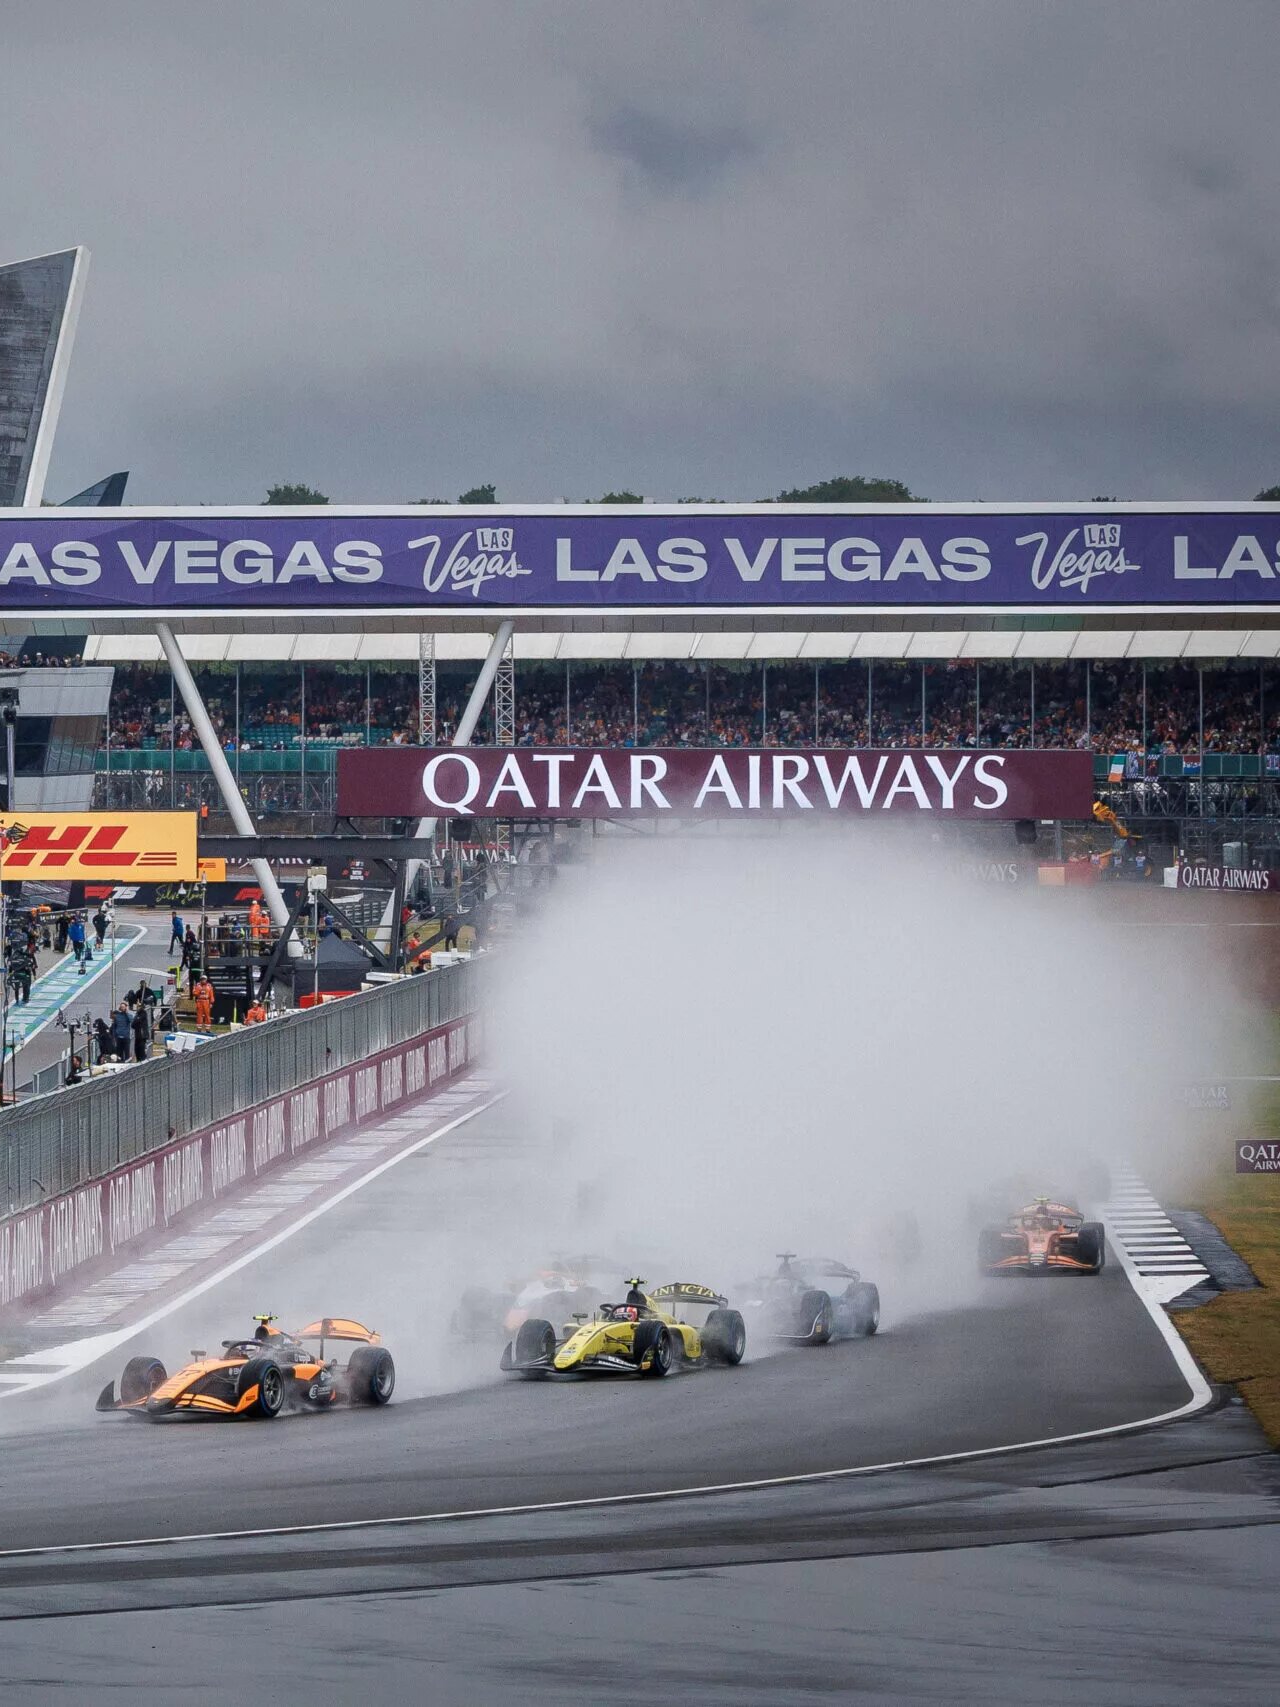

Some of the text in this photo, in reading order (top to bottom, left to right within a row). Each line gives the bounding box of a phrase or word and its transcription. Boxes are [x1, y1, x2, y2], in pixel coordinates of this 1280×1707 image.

[481, 530, 511, 549] LAS
[1088, 527, 1117, 545] LAS
[1174, 536, 1280, 579] LA
[118, 540, 384, 585] VEGAS
[408, 532, 532, 597] Vegas
[557, 537, 991, 582] LAS VEGAS
[1016, 529, 1141, 593] Vegas
[422, 754, 1008, 815] QATAR AIRWAYS
[1182, 867, 1269, 889] QATAR AIRWAYS
